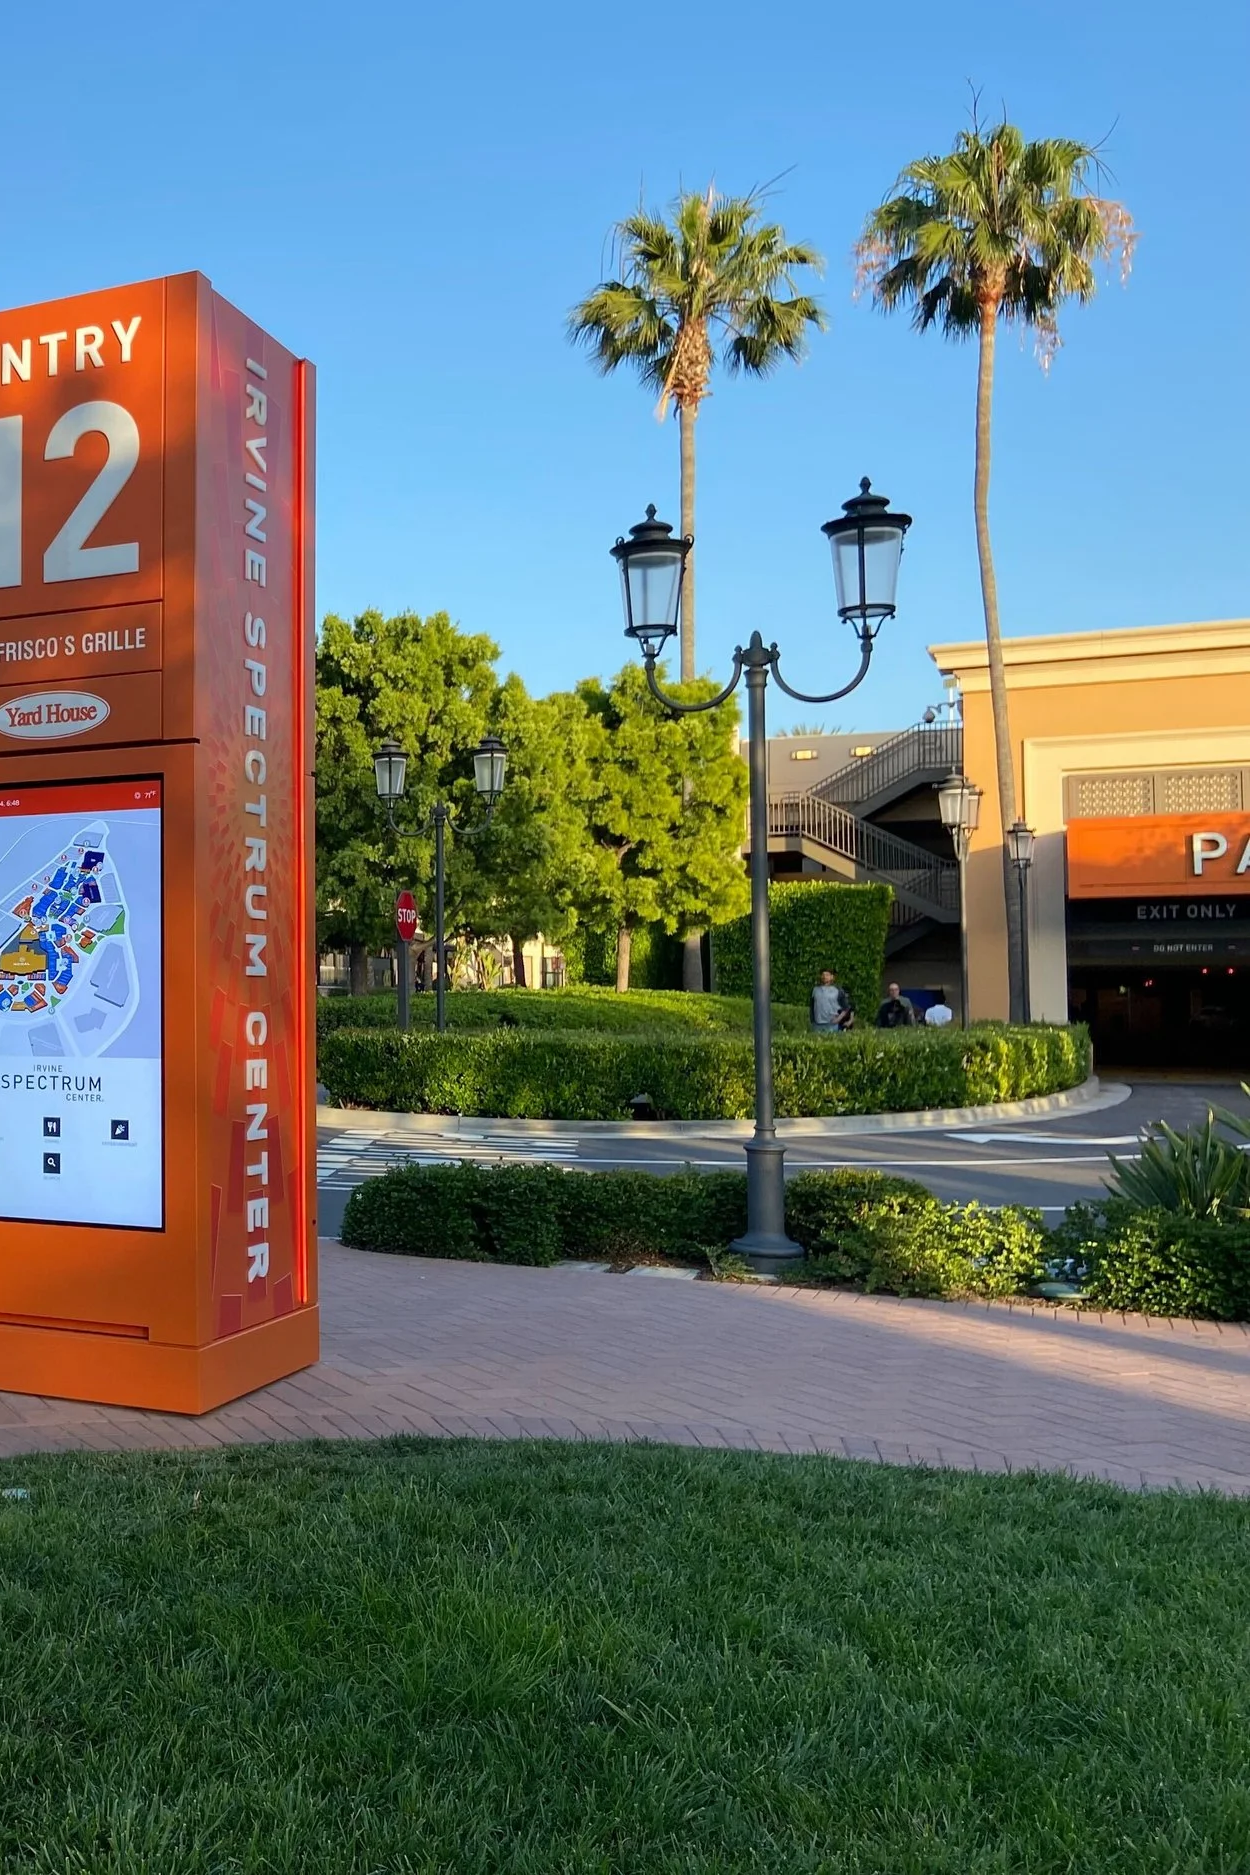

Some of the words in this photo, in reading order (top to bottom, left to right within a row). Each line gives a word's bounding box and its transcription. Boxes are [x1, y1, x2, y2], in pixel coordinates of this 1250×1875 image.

[244, 357, 268, 588] IRVINE
[81, 627, 146, 654] GRILLE
[5, 704, 43, 727] Yard
[45, 703, 98, 724] House
[244, 611, 268, 978] SPECTRUM
[397, 908, 416, 924] STOP
[1137, 904, 1180, 919] EXIT
[1186, 903, 1236, 918] ONLY
[1153, 944, 1165, 952] DO
[1167, 943, 1184, 952] NOT
[1185, 943, 1214, 952] ENTER
[33, 1064, 63, 1073] IRVINE
[1, 1074, 102, 1092] SPECTRUM
[244, 1011, 269, 1283] CENTER
